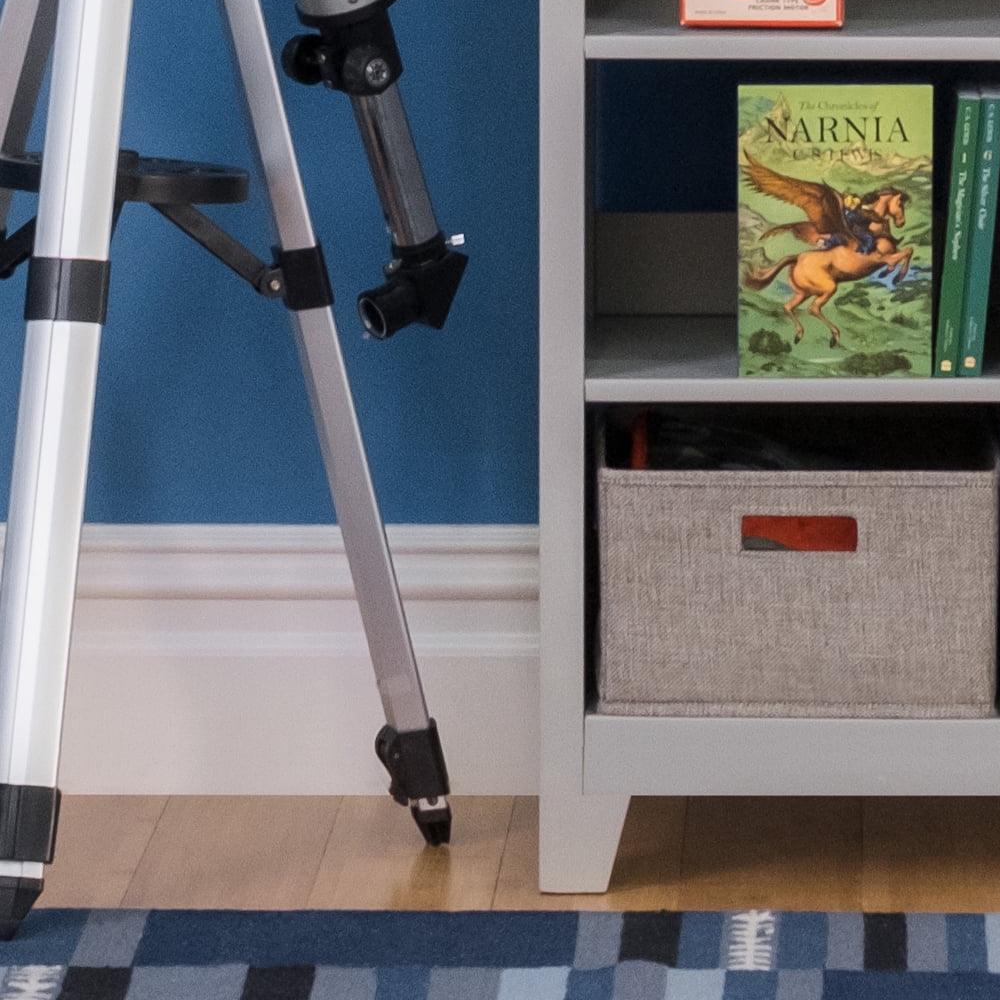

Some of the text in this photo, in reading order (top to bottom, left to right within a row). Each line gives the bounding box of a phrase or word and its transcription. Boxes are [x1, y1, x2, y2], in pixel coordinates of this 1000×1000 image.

[798, 101, 880, 112] The Chronicles of
[764, 115, 910, 143] NARNIA
[958, 171, 967, 186] The
[981, 167, 991, 184] The
